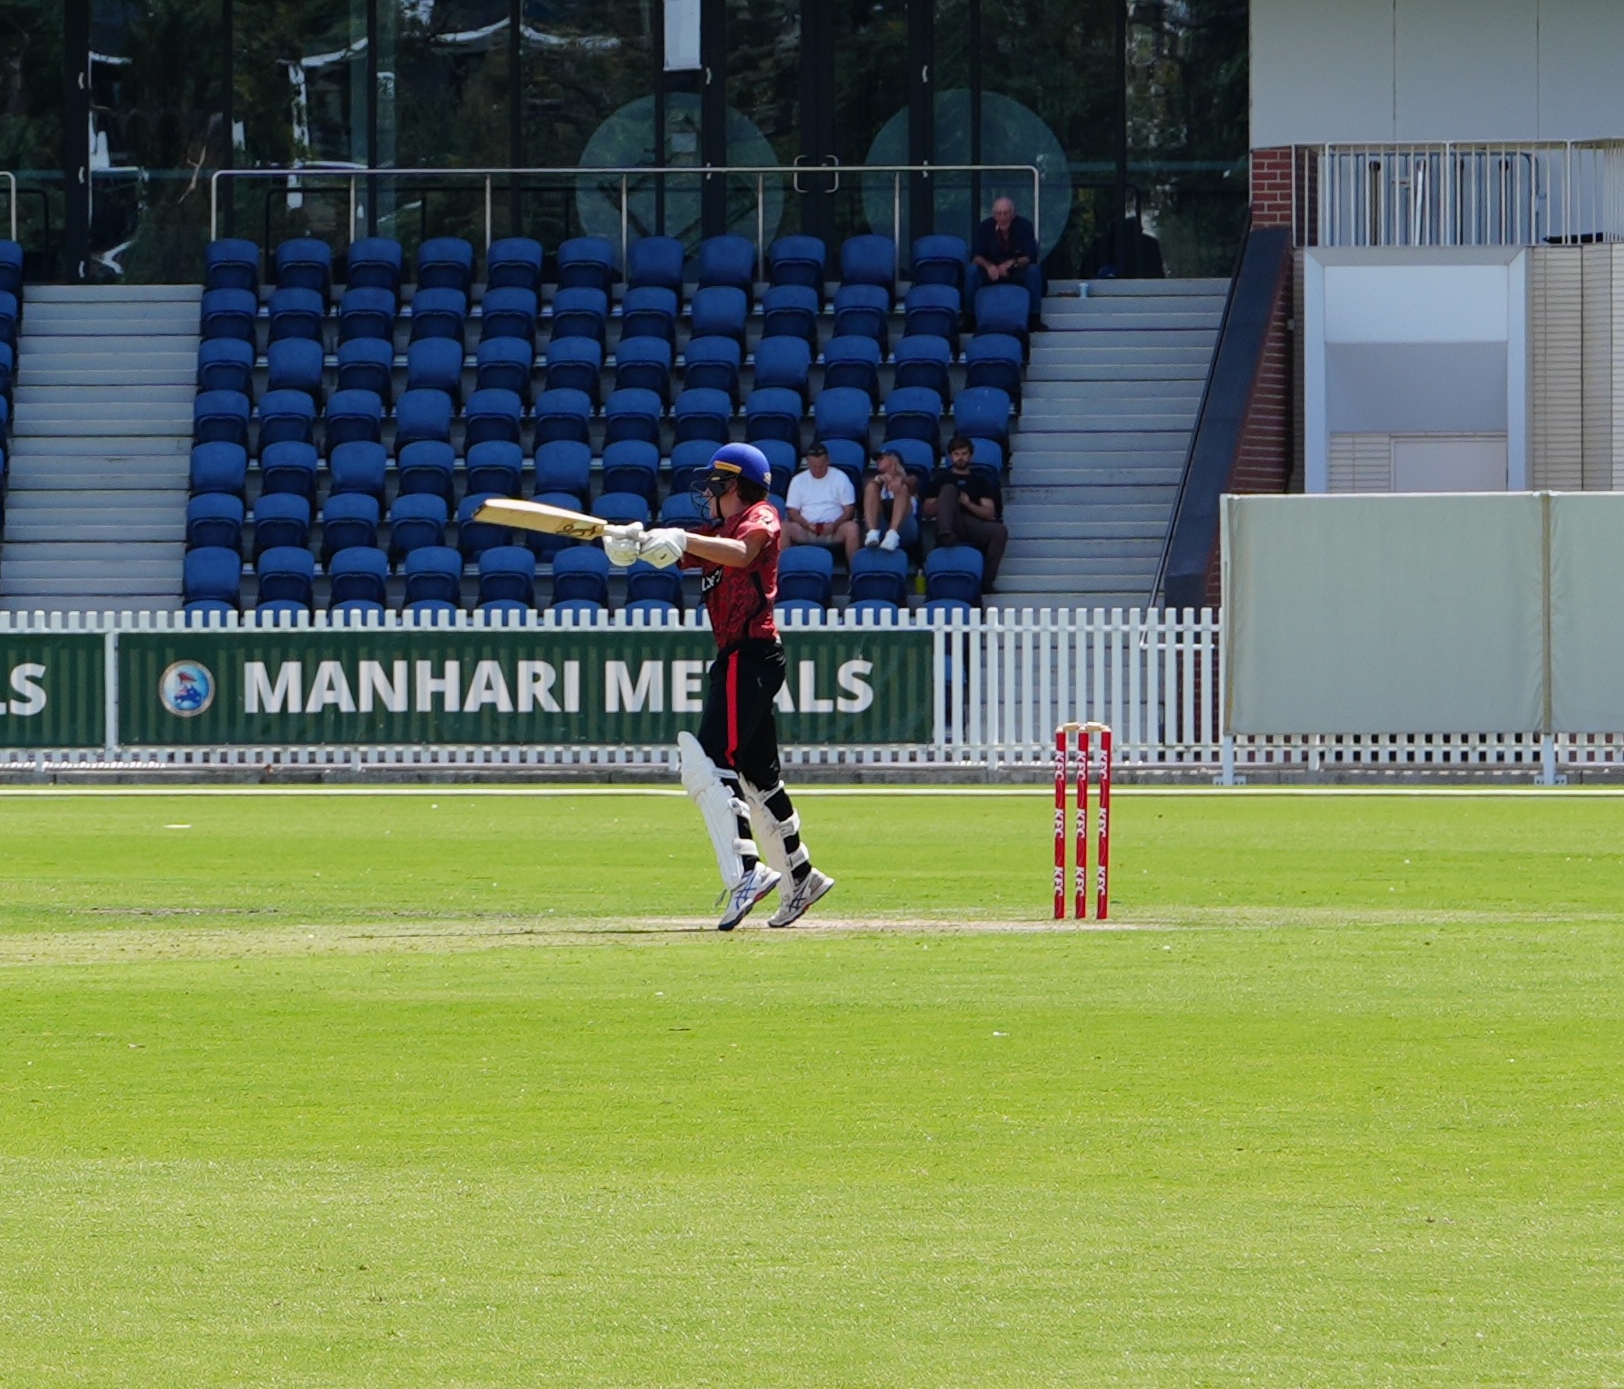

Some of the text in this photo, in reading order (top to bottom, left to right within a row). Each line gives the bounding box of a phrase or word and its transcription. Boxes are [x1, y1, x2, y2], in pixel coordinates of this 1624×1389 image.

[244, 659, 874, 714] MANHARI MELS
[1054, 750, 1065, 780] KFC
[1076, 750, 1086, 780] KFC
[1099, 750, 1108, 780] KFC
[1054, 808, 1064, 838] KFC
[1076, 808, 1085, 838] KFC
[1098, 807, 1107, 837] KFC
[1054, 866, 1064, 896] KFC
[1075, 866, 1085, 896] KFC
[1097, 865, 1106, 896] KFC
